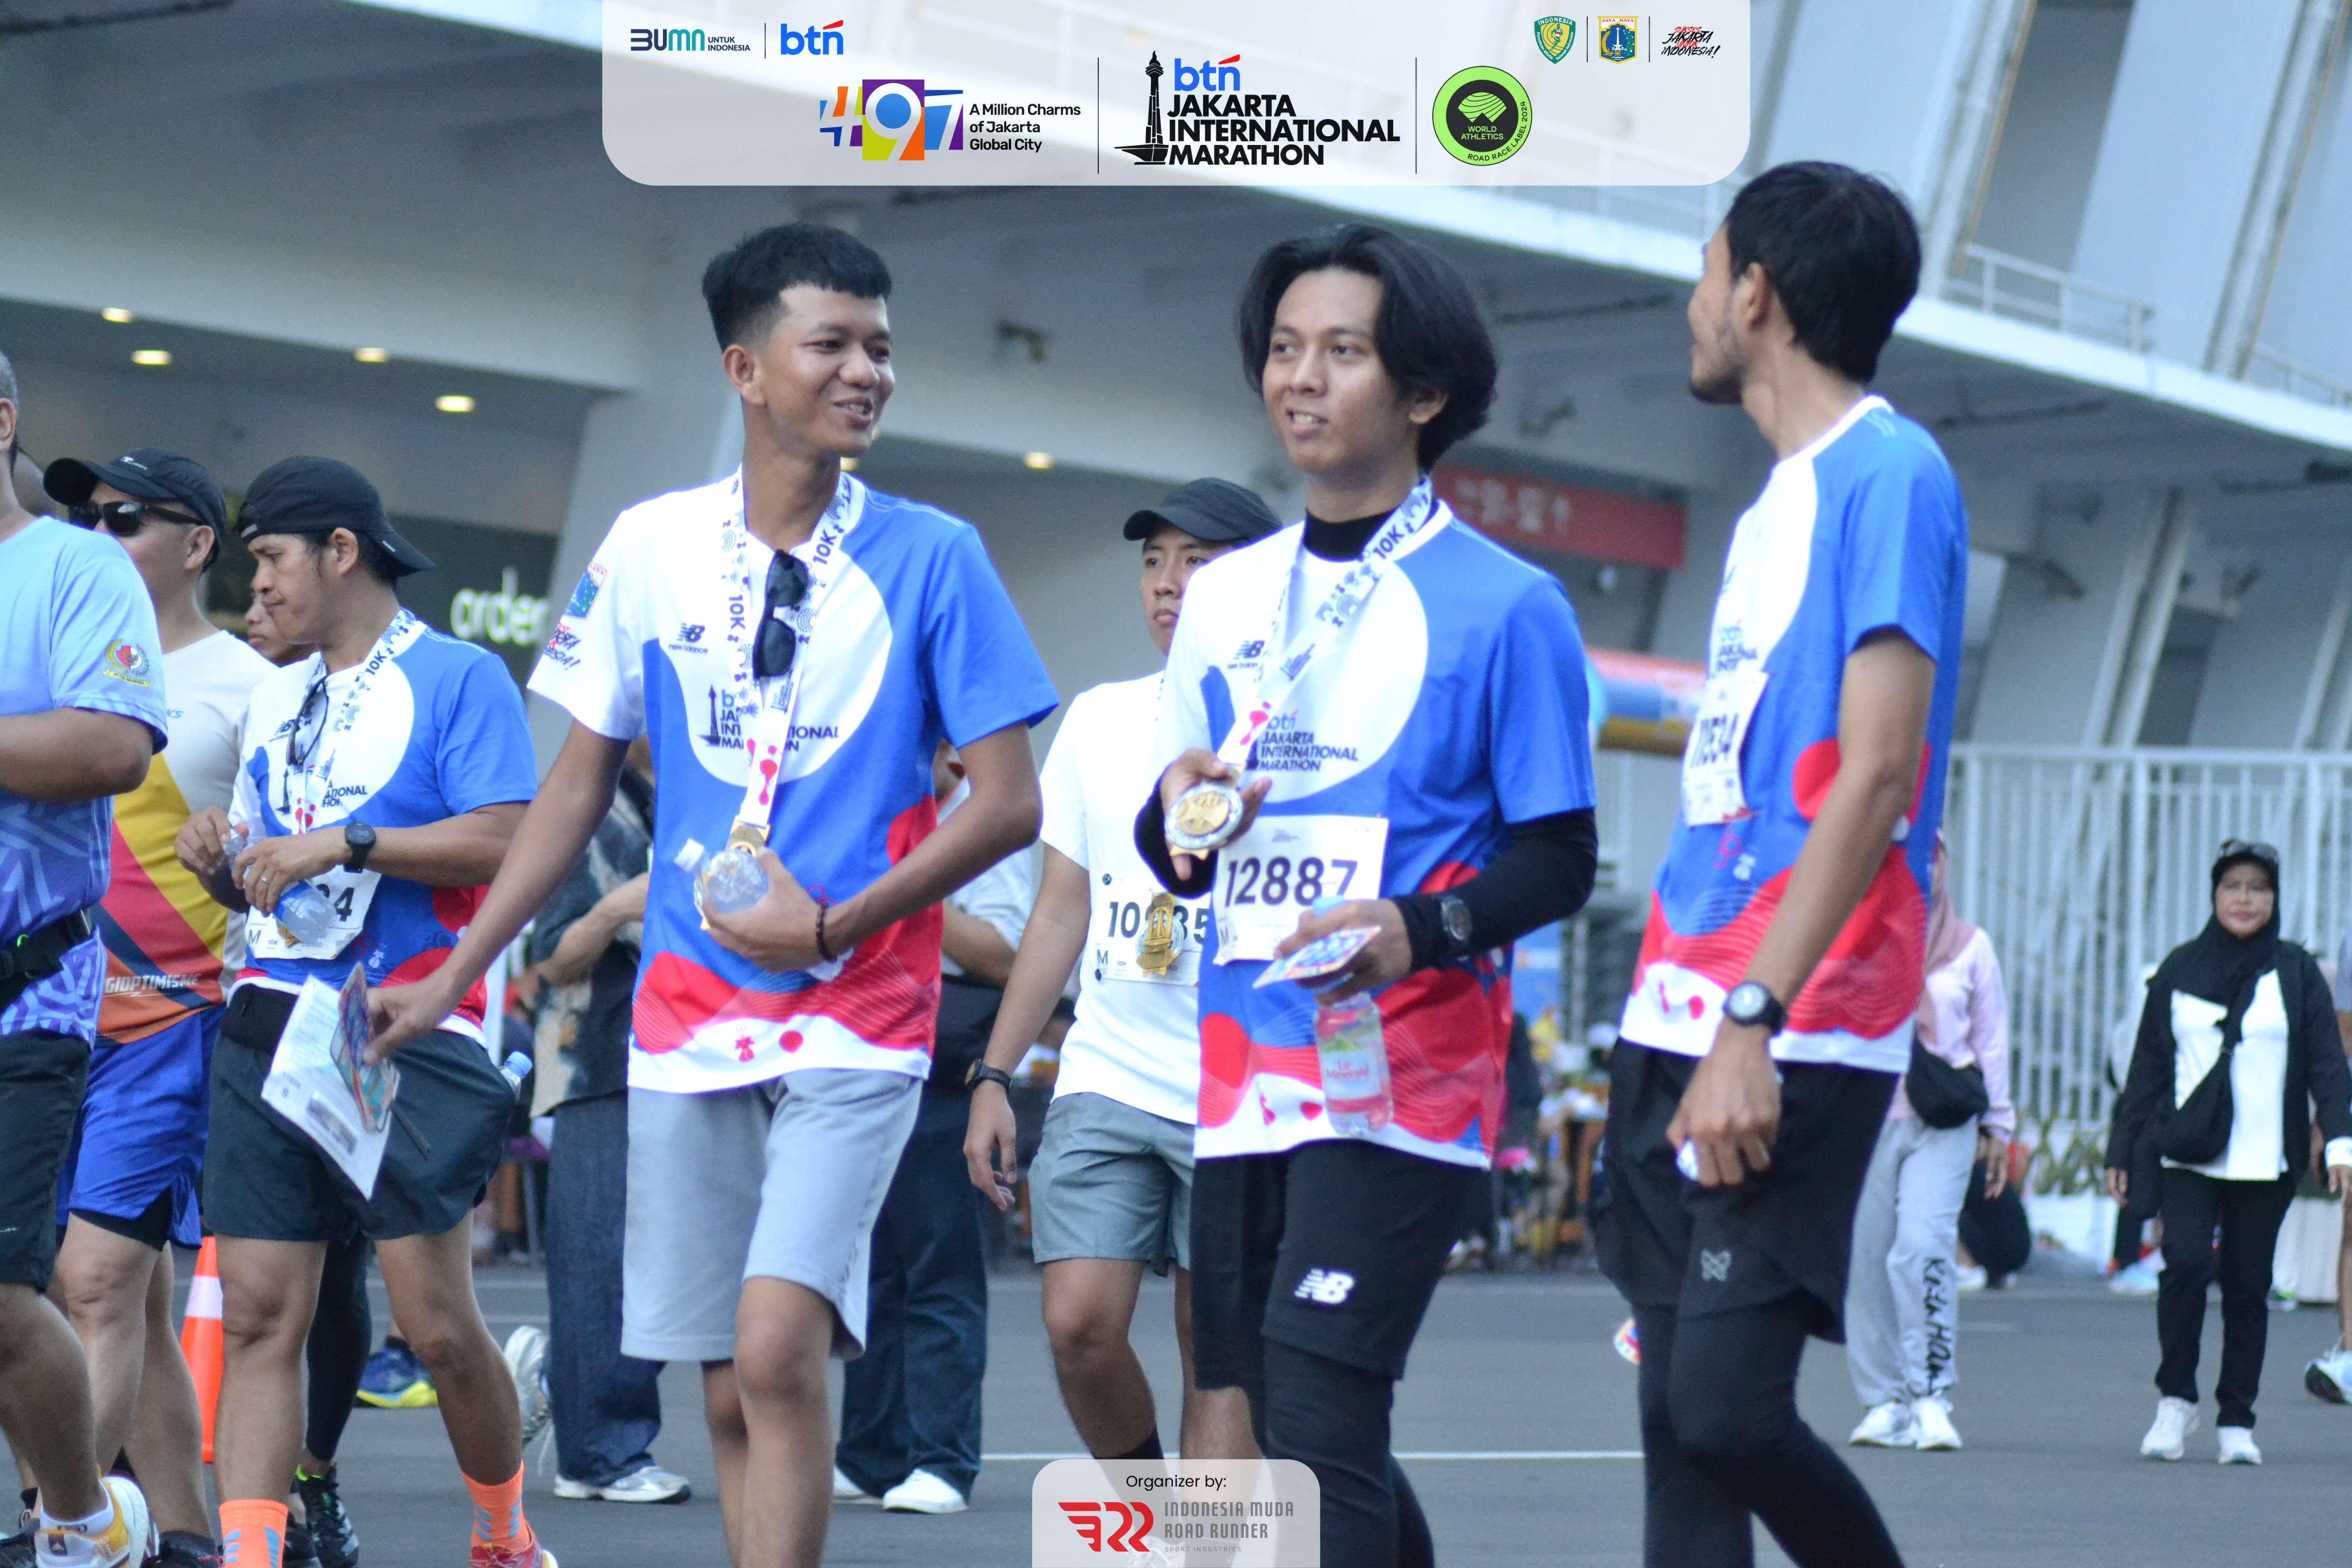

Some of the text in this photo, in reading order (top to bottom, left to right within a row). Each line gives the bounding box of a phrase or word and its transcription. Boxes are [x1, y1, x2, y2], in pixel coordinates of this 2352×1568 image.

[812, 529, 837, 565] 10K
[1373, 524, 1405, 560] 10K
[450, 566, 552, 647] order
[728, 595, 746, 630] 10K
[365, 650, 387, 675] 10K
[683, 645, 708, 654] balance
[1224, 856, 1358, 908] 12887
[248, 929, 262, 945] M
[1097, 949, 1109, 965] M
